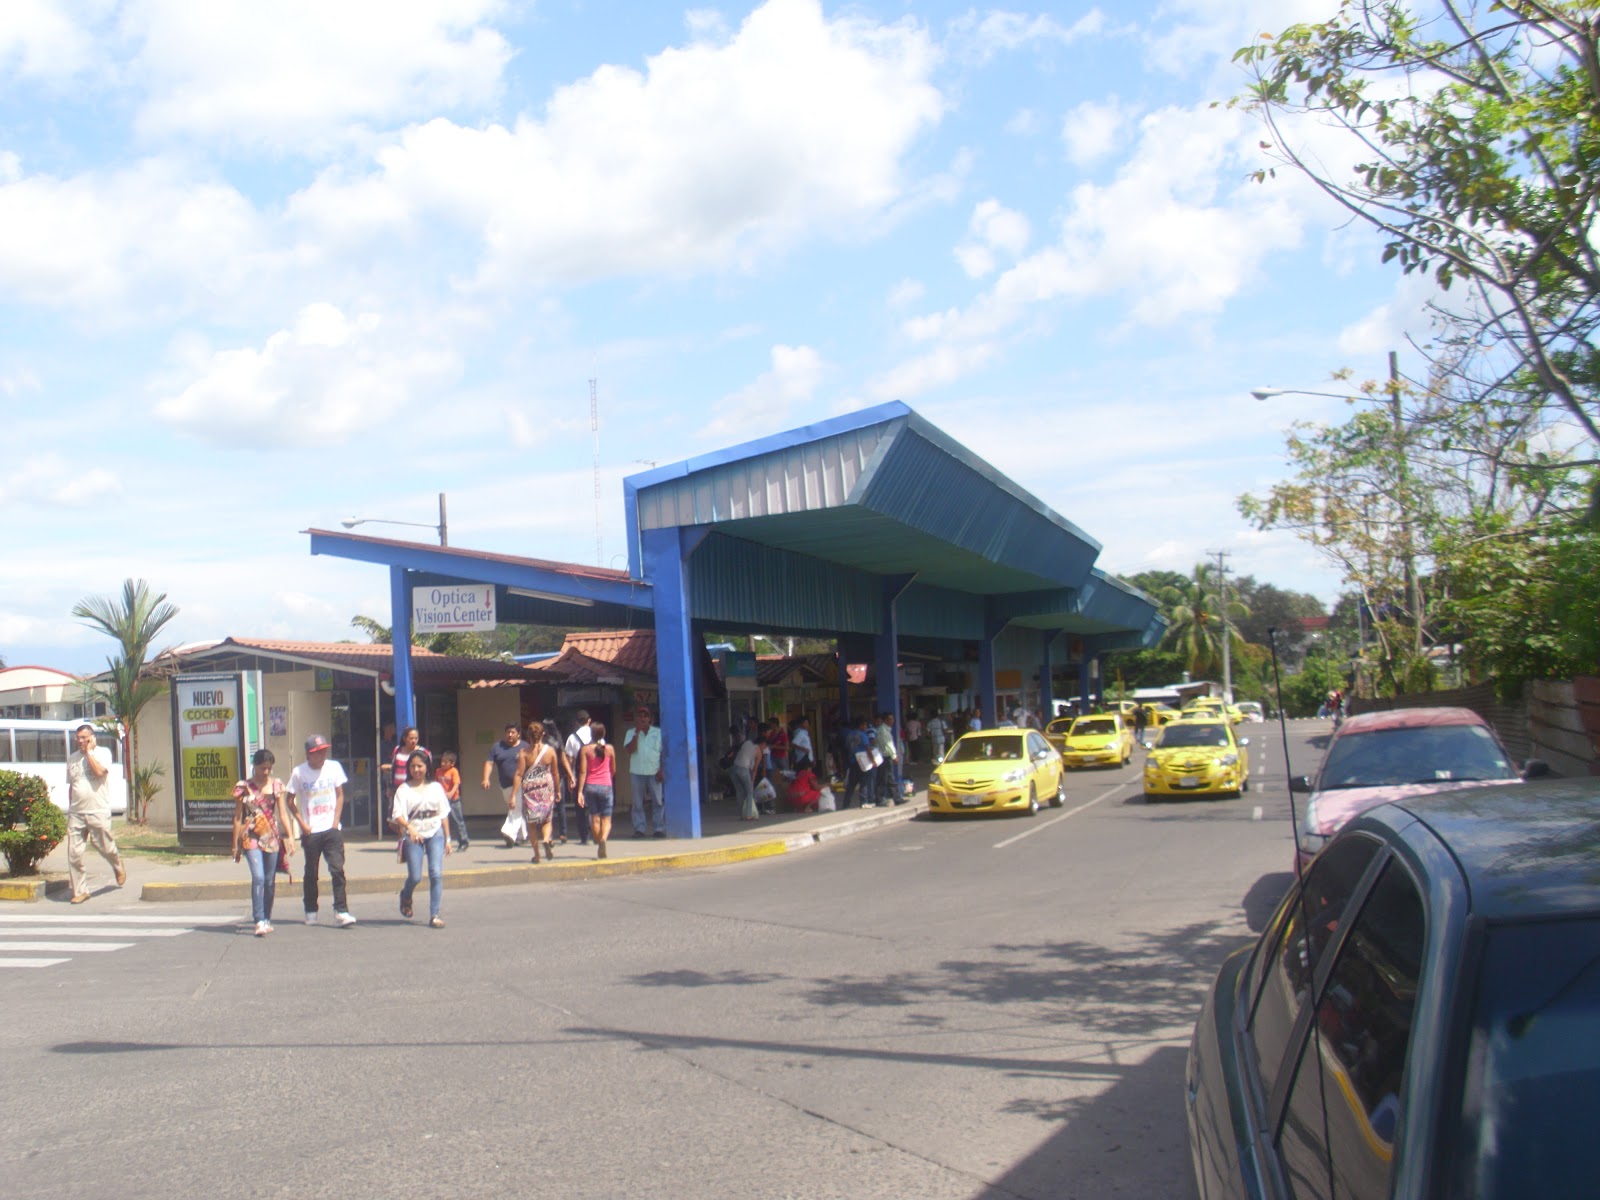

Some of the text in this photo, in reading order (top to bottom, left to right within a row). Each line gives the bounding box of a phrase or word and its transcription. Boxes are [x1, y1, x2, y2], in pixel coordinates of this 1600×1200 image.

[431, 589, 475, 608] Optica
[416, 606, 492, 623] Vision Center
[193, 691, 223, 706] NUEVO
[187, 709, 229, 720] COCHEZ
[196, 749, 220, 766] ESTÁS
[190, 766, 229, 780] CERQUITA
